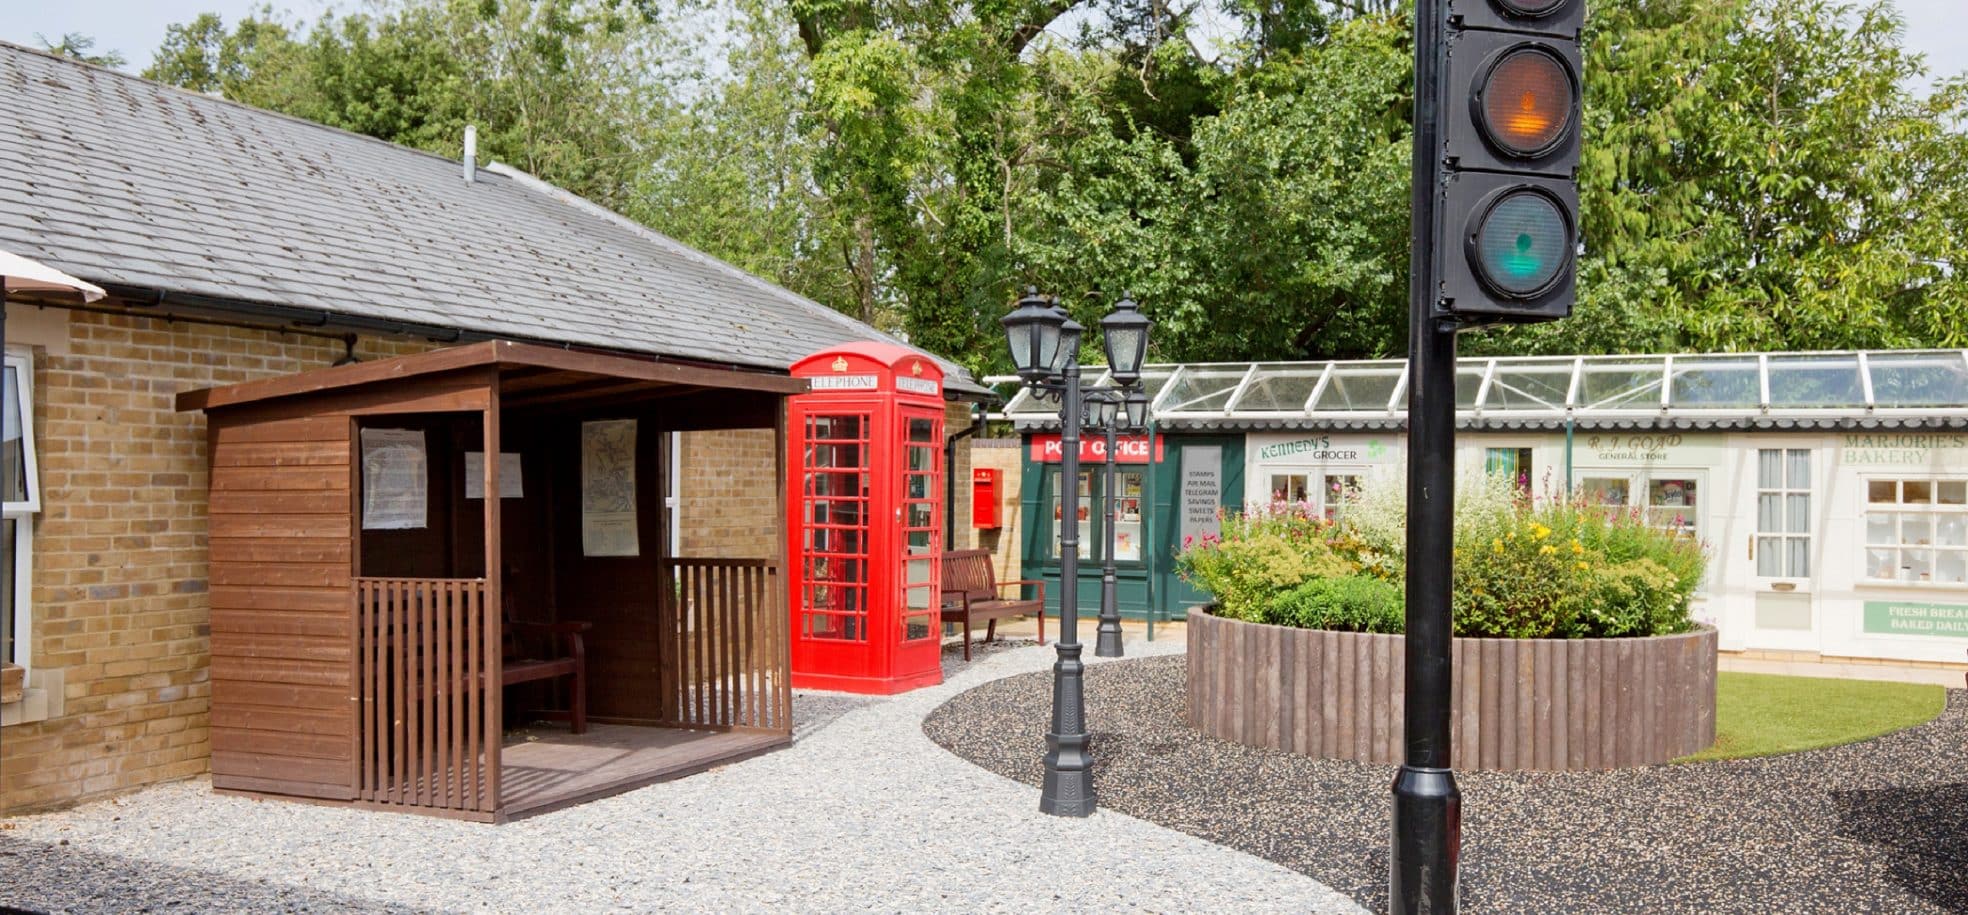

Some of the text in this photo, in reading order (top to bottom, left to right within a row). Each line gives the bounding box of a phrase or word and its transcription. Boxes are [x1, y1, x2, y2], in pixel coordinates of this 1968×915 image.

[812, 375, 873, 388] ELEPHONE
[1045, 440, 1149, 455] PT OFICE
[1261, 435, 1330, 459] KENNEDY'S
[1844, 434, 1966, 449] MARJORIE'S
[1313, 450, 1357, 460] GROCER
[1599, 452, 1668, 461] GENERAL STORE
[1844, 450, 1928, 465] BAKERY
[1889, 606, 1927, 617] FRESH
[1891, 618, 1934, 630] BAKED
